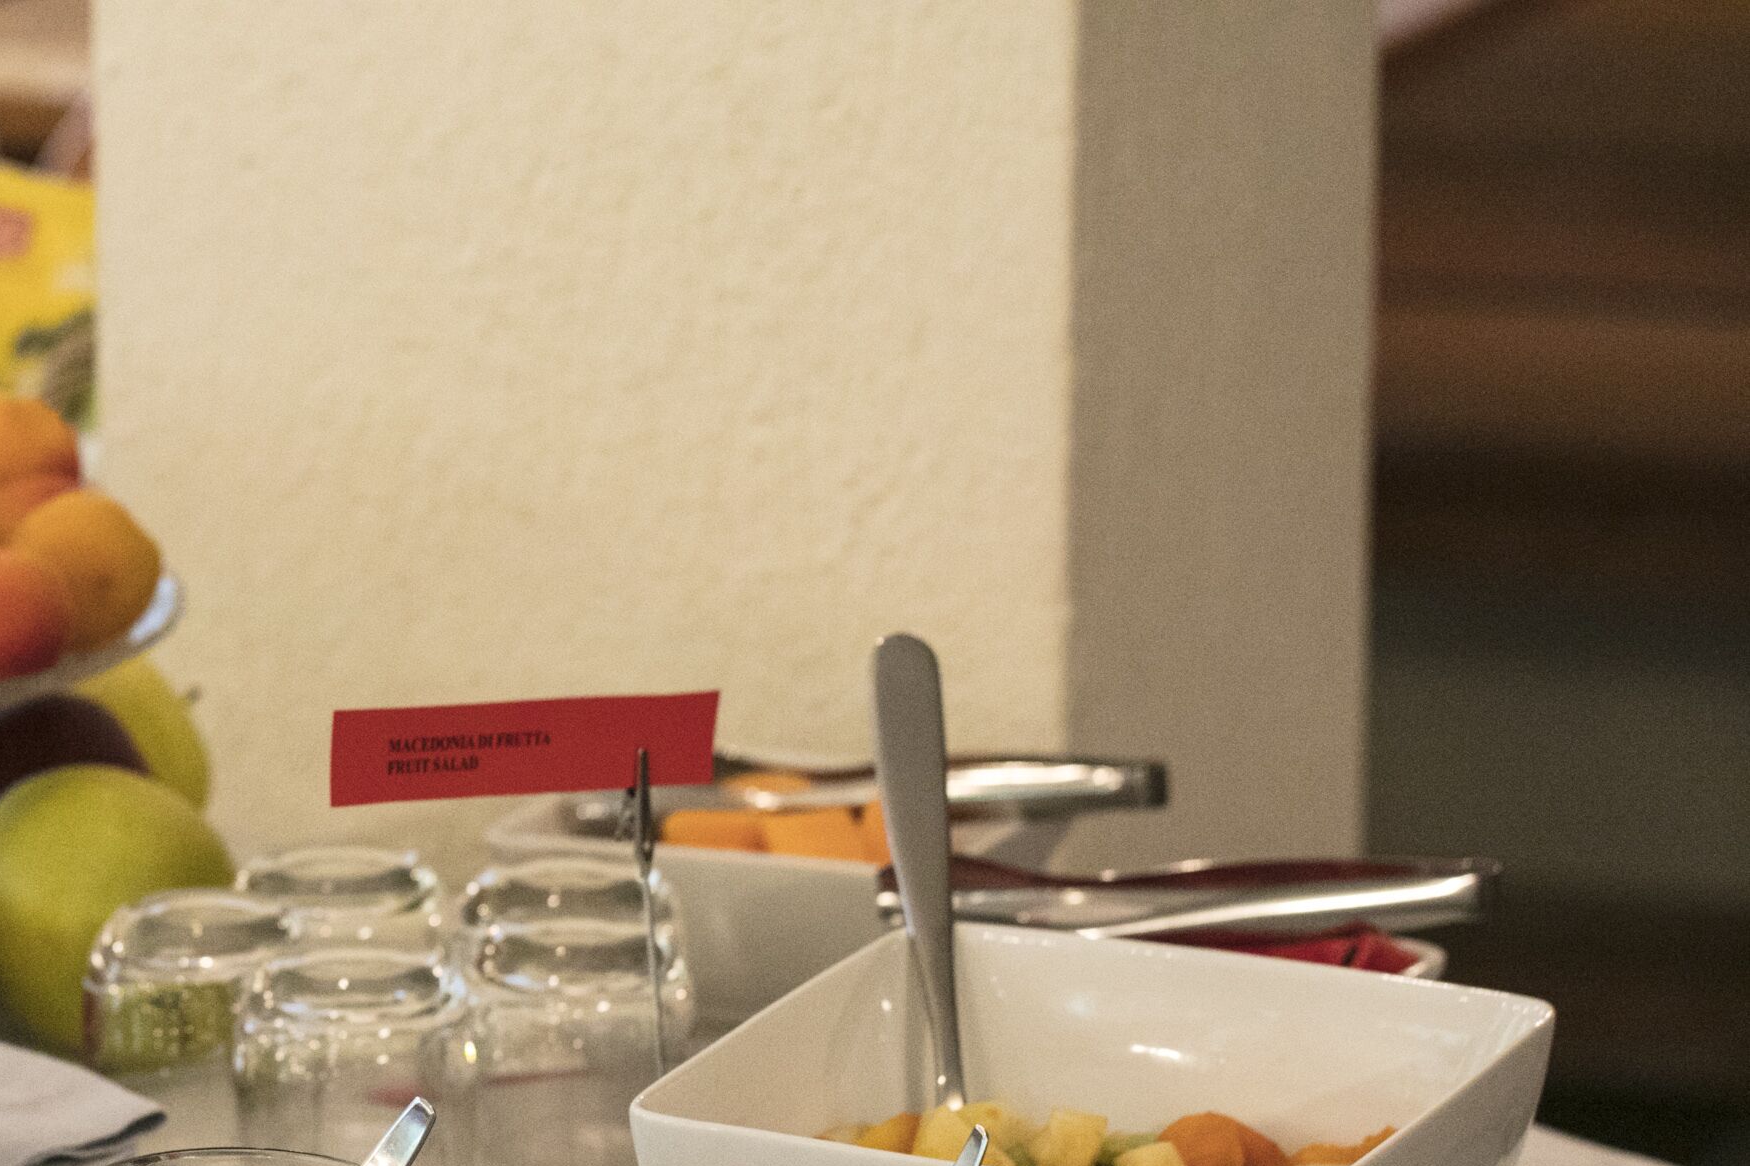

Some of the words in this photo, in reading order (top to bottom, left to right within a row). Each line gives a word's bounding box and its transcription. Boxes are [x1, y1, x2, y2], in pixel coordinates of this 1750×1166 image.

[388, 735, 475, 752] MACEDONIA
[477, 733, 494, 749] DI
[495, 730, 552, 748] FRUTTA
[386, 758, 430, 775] FRUIT
[432, 755, 480, 772] SALAD
